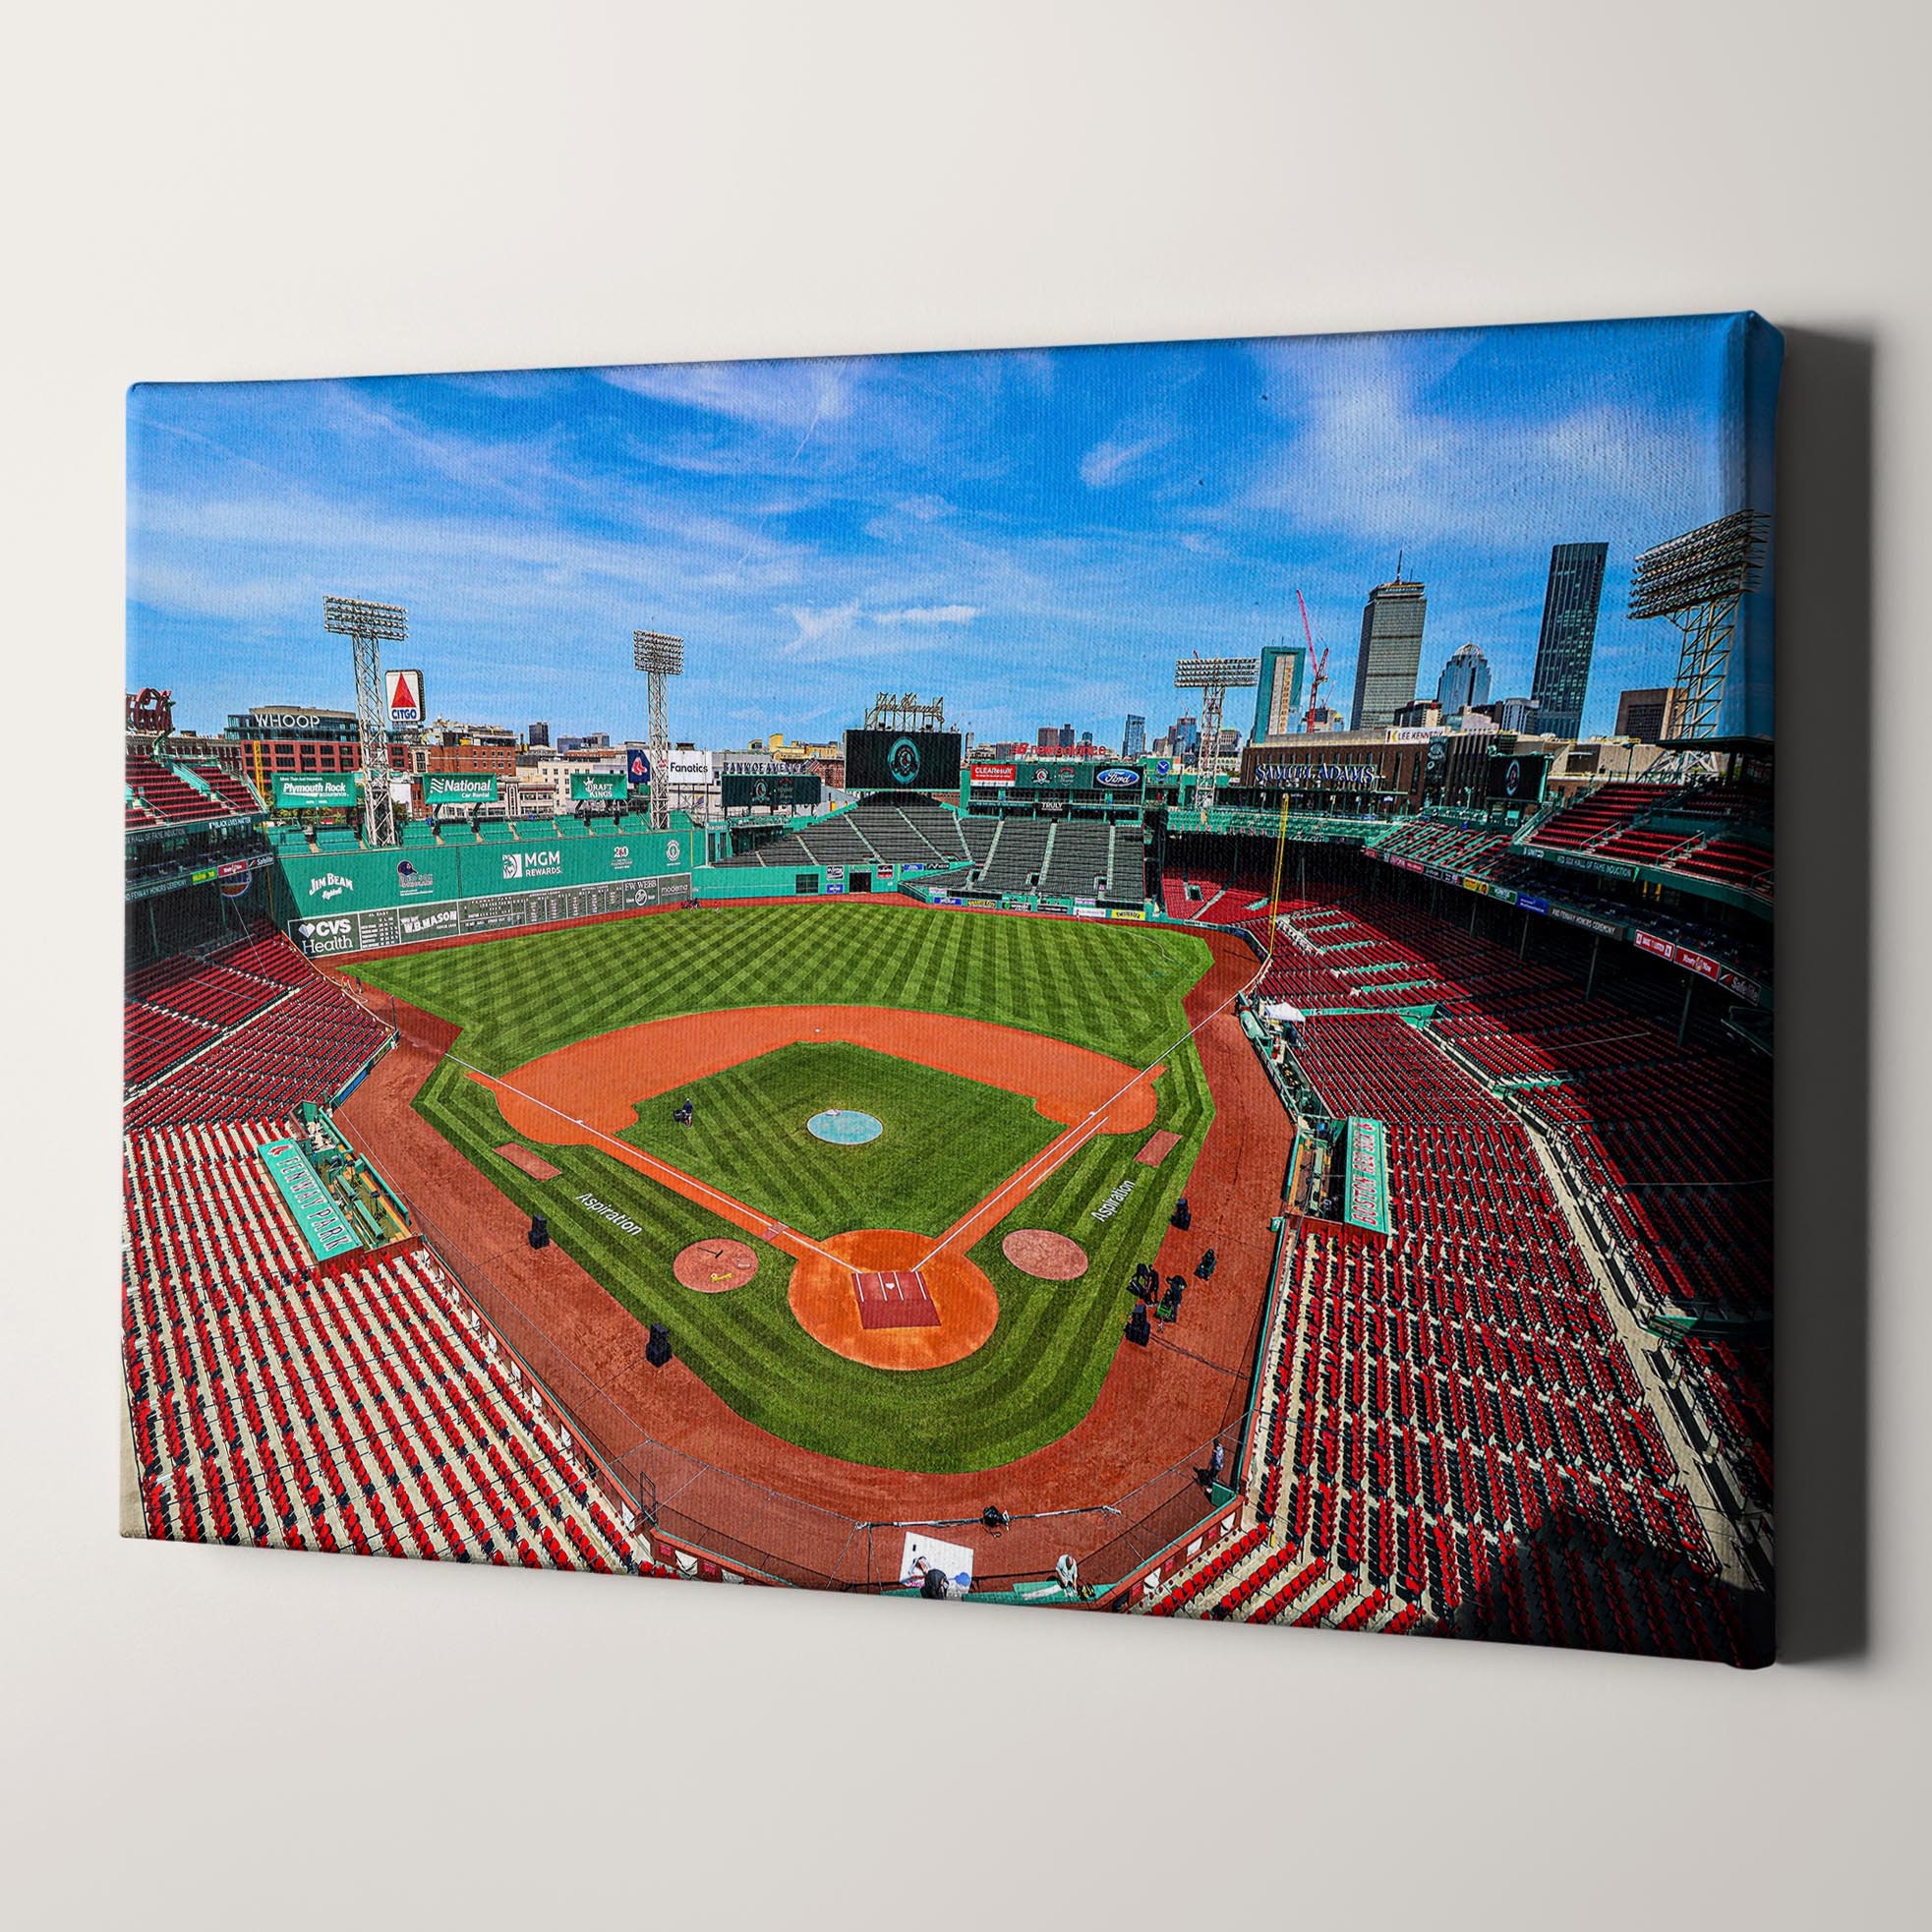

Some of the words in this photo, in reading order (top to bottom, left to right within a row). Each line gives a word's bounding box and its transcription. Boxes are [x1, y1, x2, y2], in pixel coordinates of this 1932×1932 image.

[256, 715, 321, 728] WHOOP
[391, 709, 417, 719] CITGO
[671, 762, 709, 773] Fanatics
[1255, 764, 1316, 784] SAMUEL
[1318, 763, 1375, 784] ADAMS
[444, 779, 491, 792] National
[1104, 772, 1131, 783] Ford
[283, 783, 322, 792] Plymouth
[324, 783, 346, 792] Rock
[524, 850, 560, 867] MGM
[525, 866, 561, 877] REWARDS
[309, 878, 326, 896] JIM
[327, 873, 354, 891] BEAM
[316, 918, 352, 937] CVS
[302, 935, 353, 955] Health
[1353, 1130, 1375, 1152] SOX
[1353, 1150, 1375, 1175] RED
[276, 1157, 328, 1209] FENWAY
[307, 1208, 352, 1252] PARK
[1090, 1180, 1136, 1222] Aspiration
[1352, 1174, 1377, 1226] BOSTON
[575, 1193, 642, 1236] Aspiration
